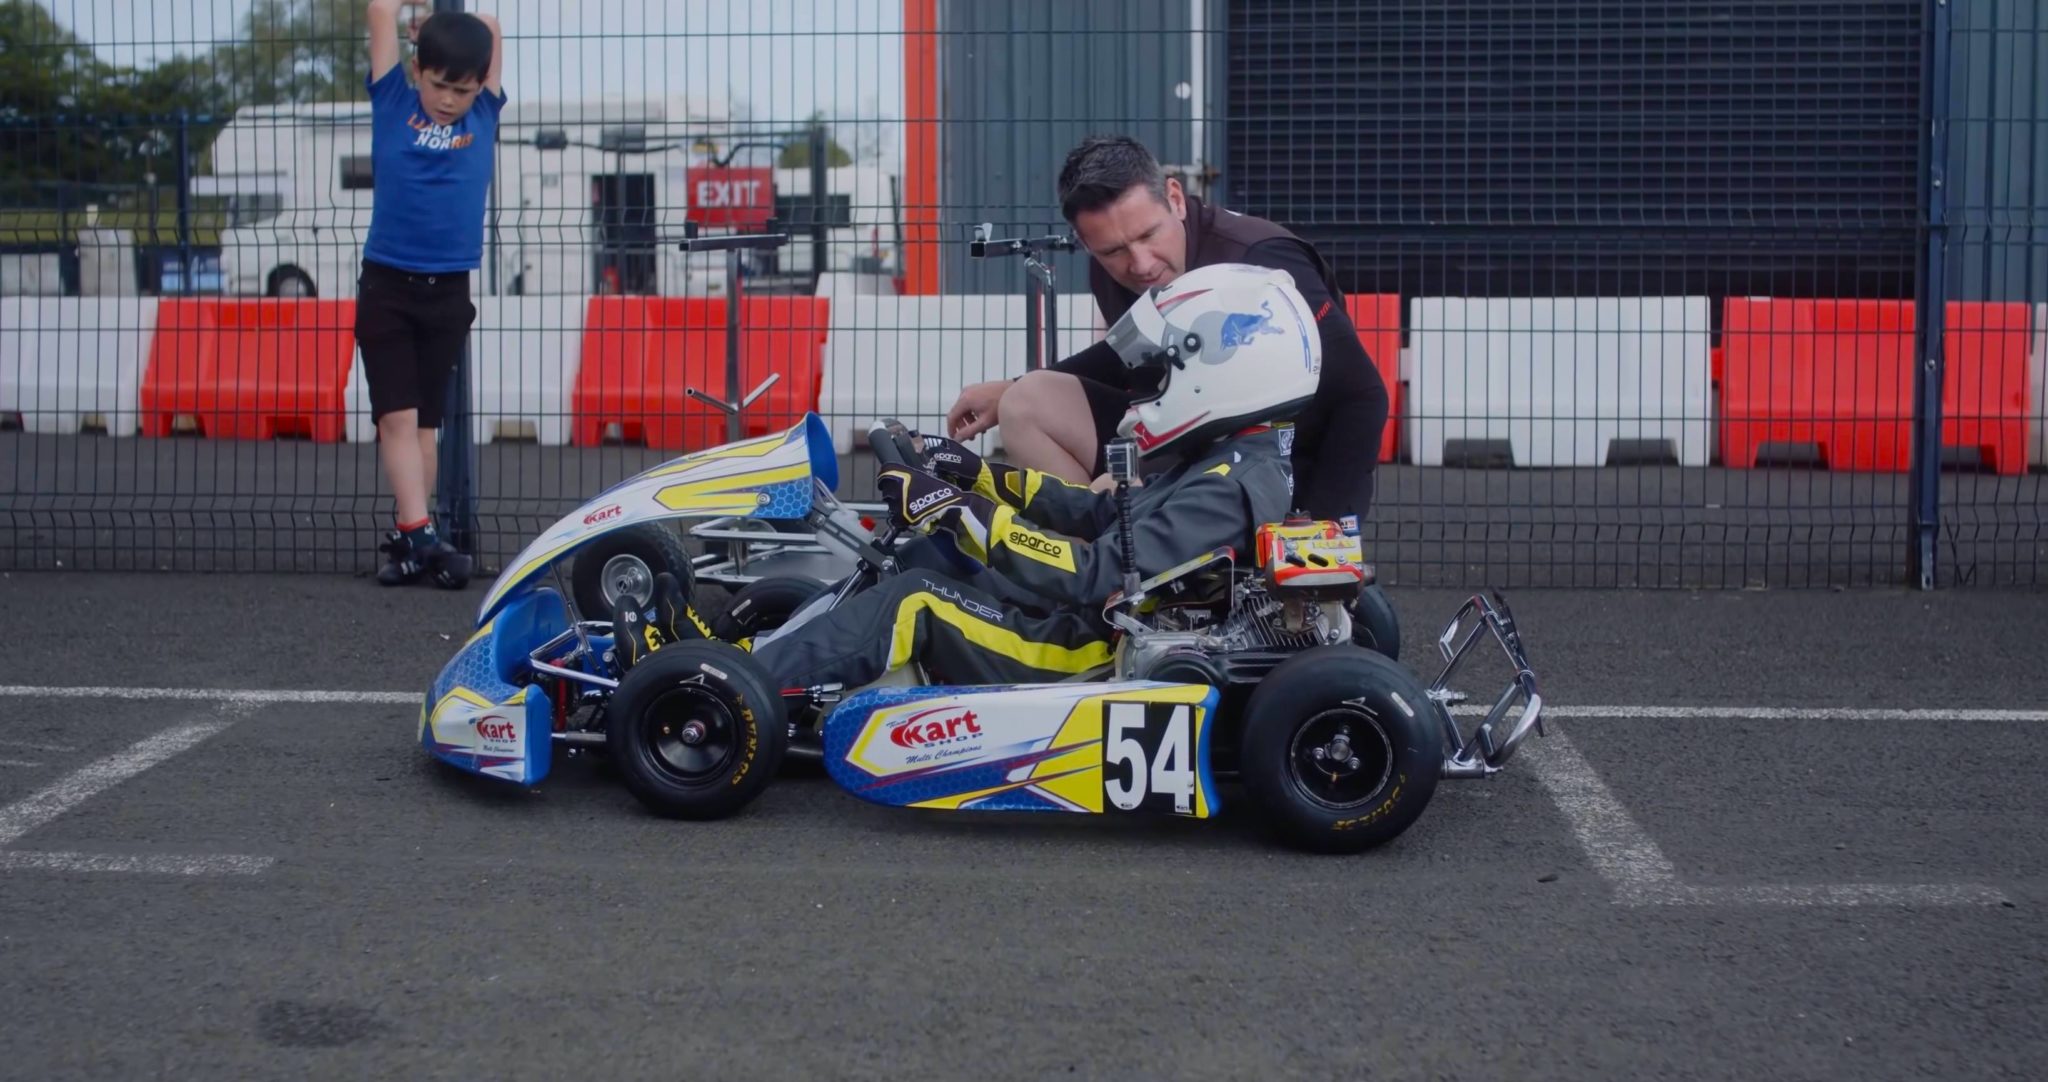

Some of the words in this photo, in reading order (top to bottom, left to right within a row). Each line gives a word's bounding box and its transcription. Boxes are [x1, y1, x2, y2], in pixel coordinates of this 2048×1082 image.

[697, 181, 760, 208] EXIT
[933, 452, 962, 464] sparco
[909, 488, 953, 514] sparco
[1009, 531, 1062, 558] sparco
[921, 578, 1004, 622] THUNDER
[1104, 703, 1195, 810] 54
